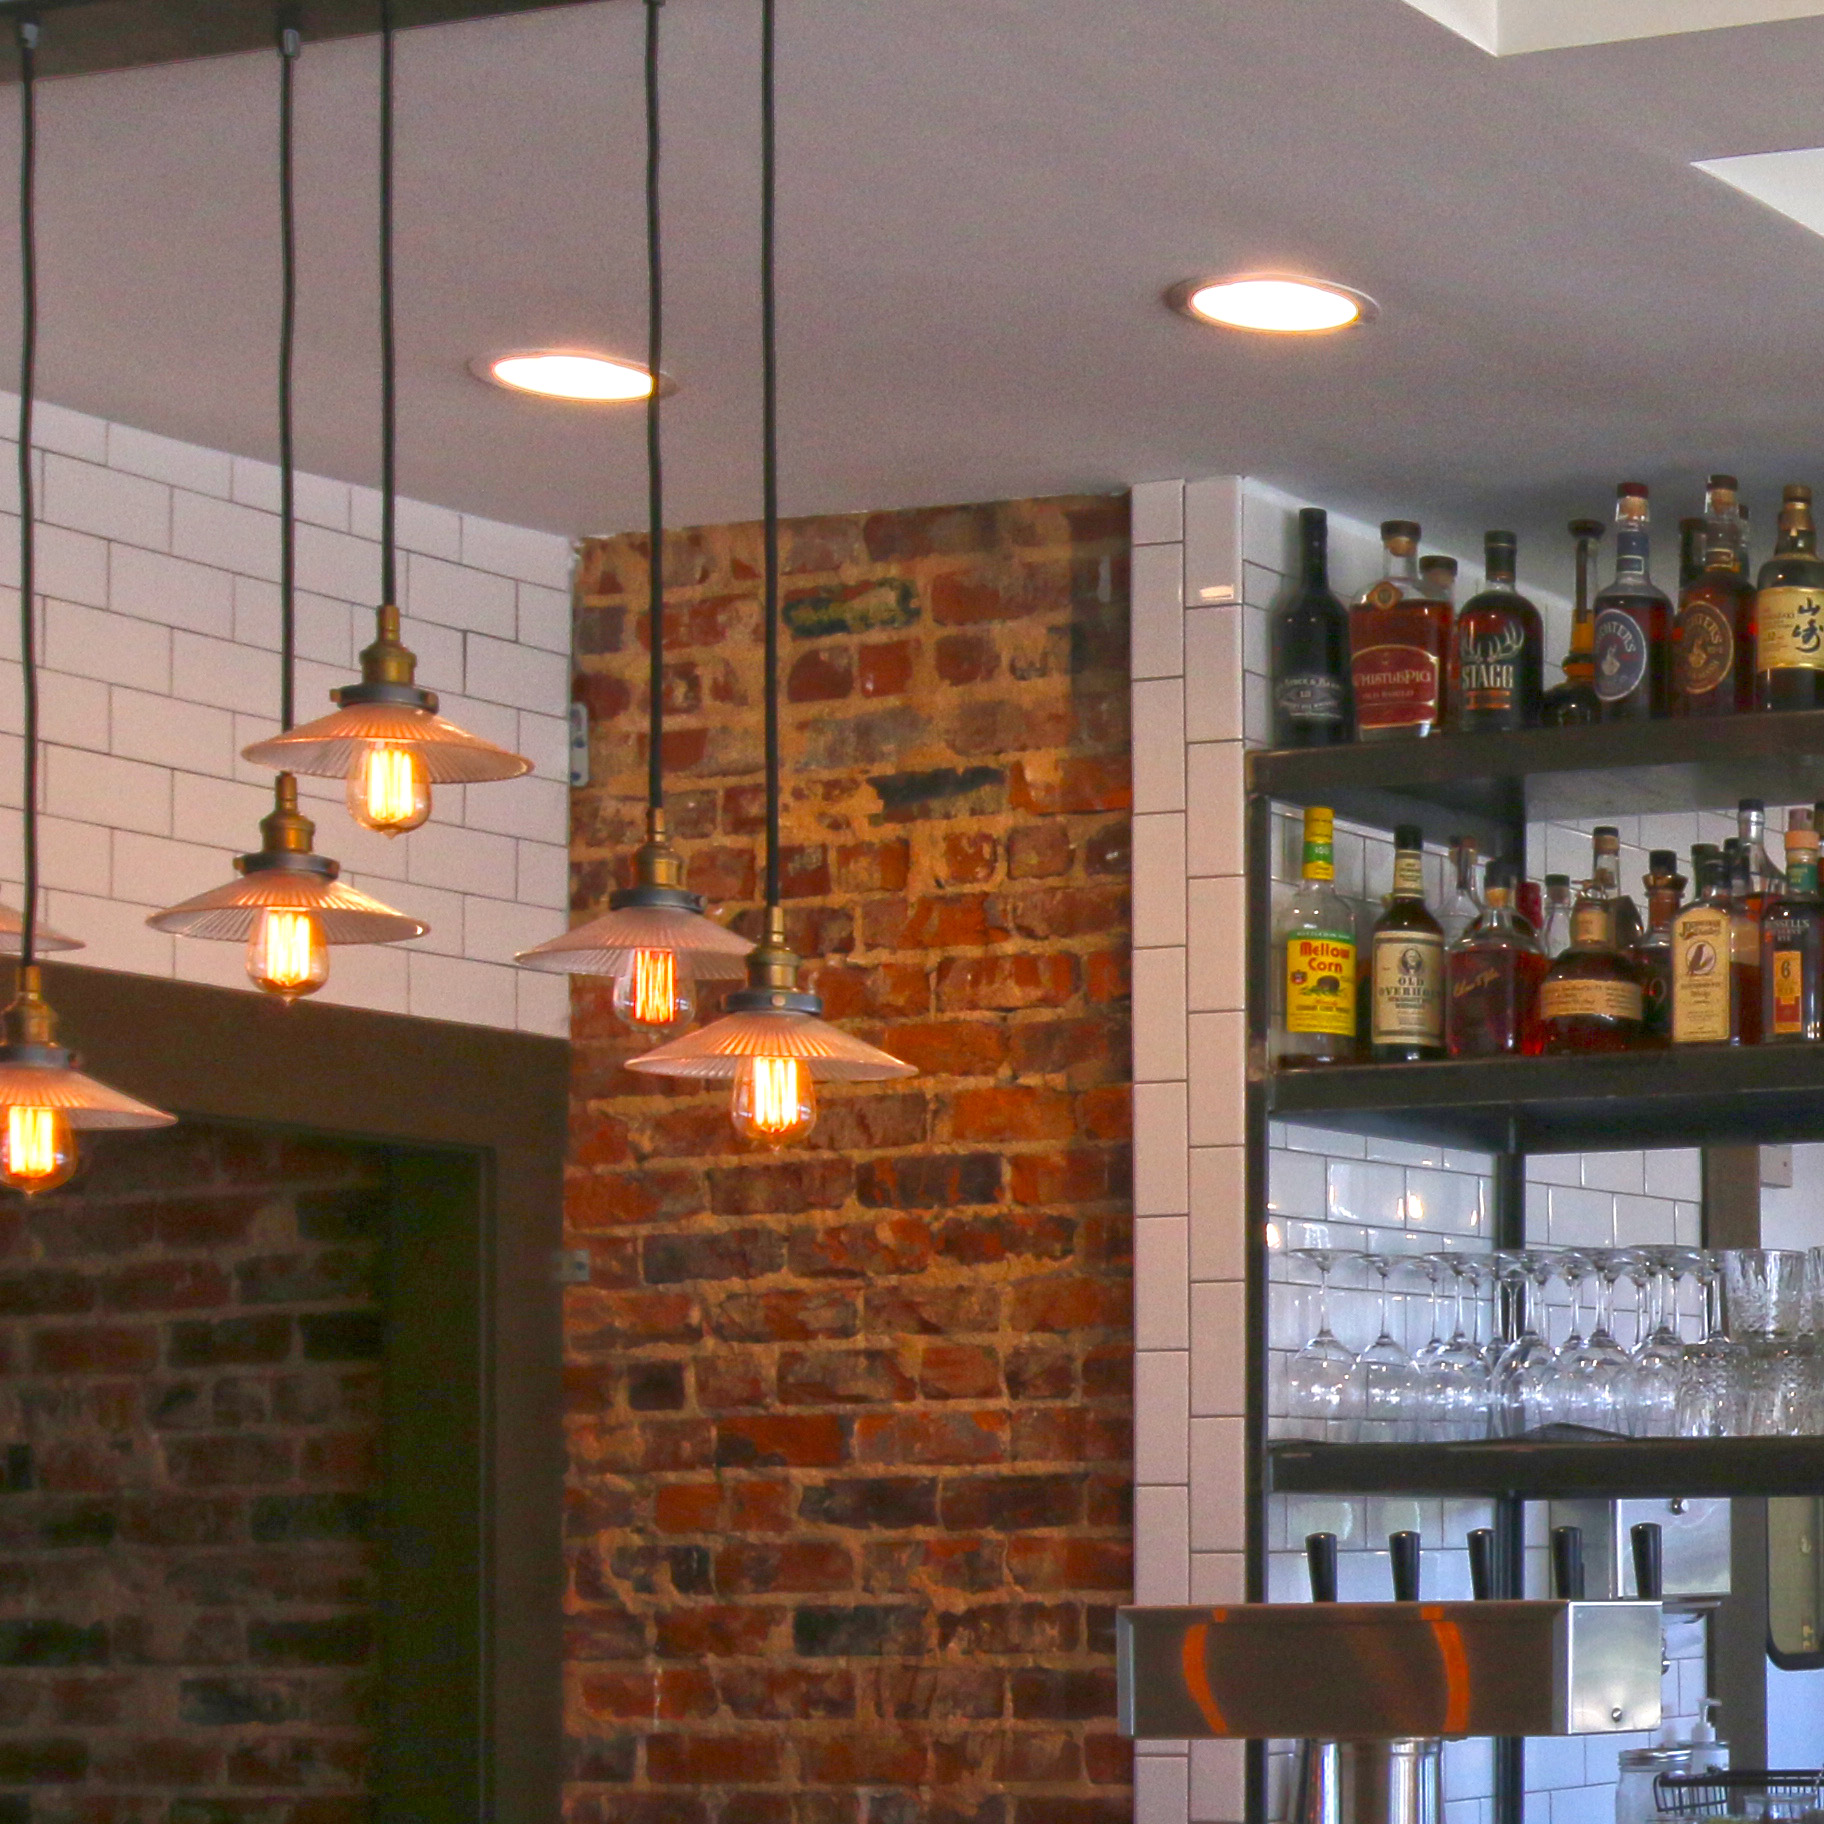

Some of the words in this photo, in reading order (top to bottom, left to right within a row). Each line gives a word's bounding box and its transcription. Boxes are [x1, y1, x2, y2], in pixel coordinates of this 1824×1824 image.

[1462, 665, 1514, 689] STAGG
[1300, 942, 1350, 959] Mellow
[1308, 957, 1342, 974] Corn
